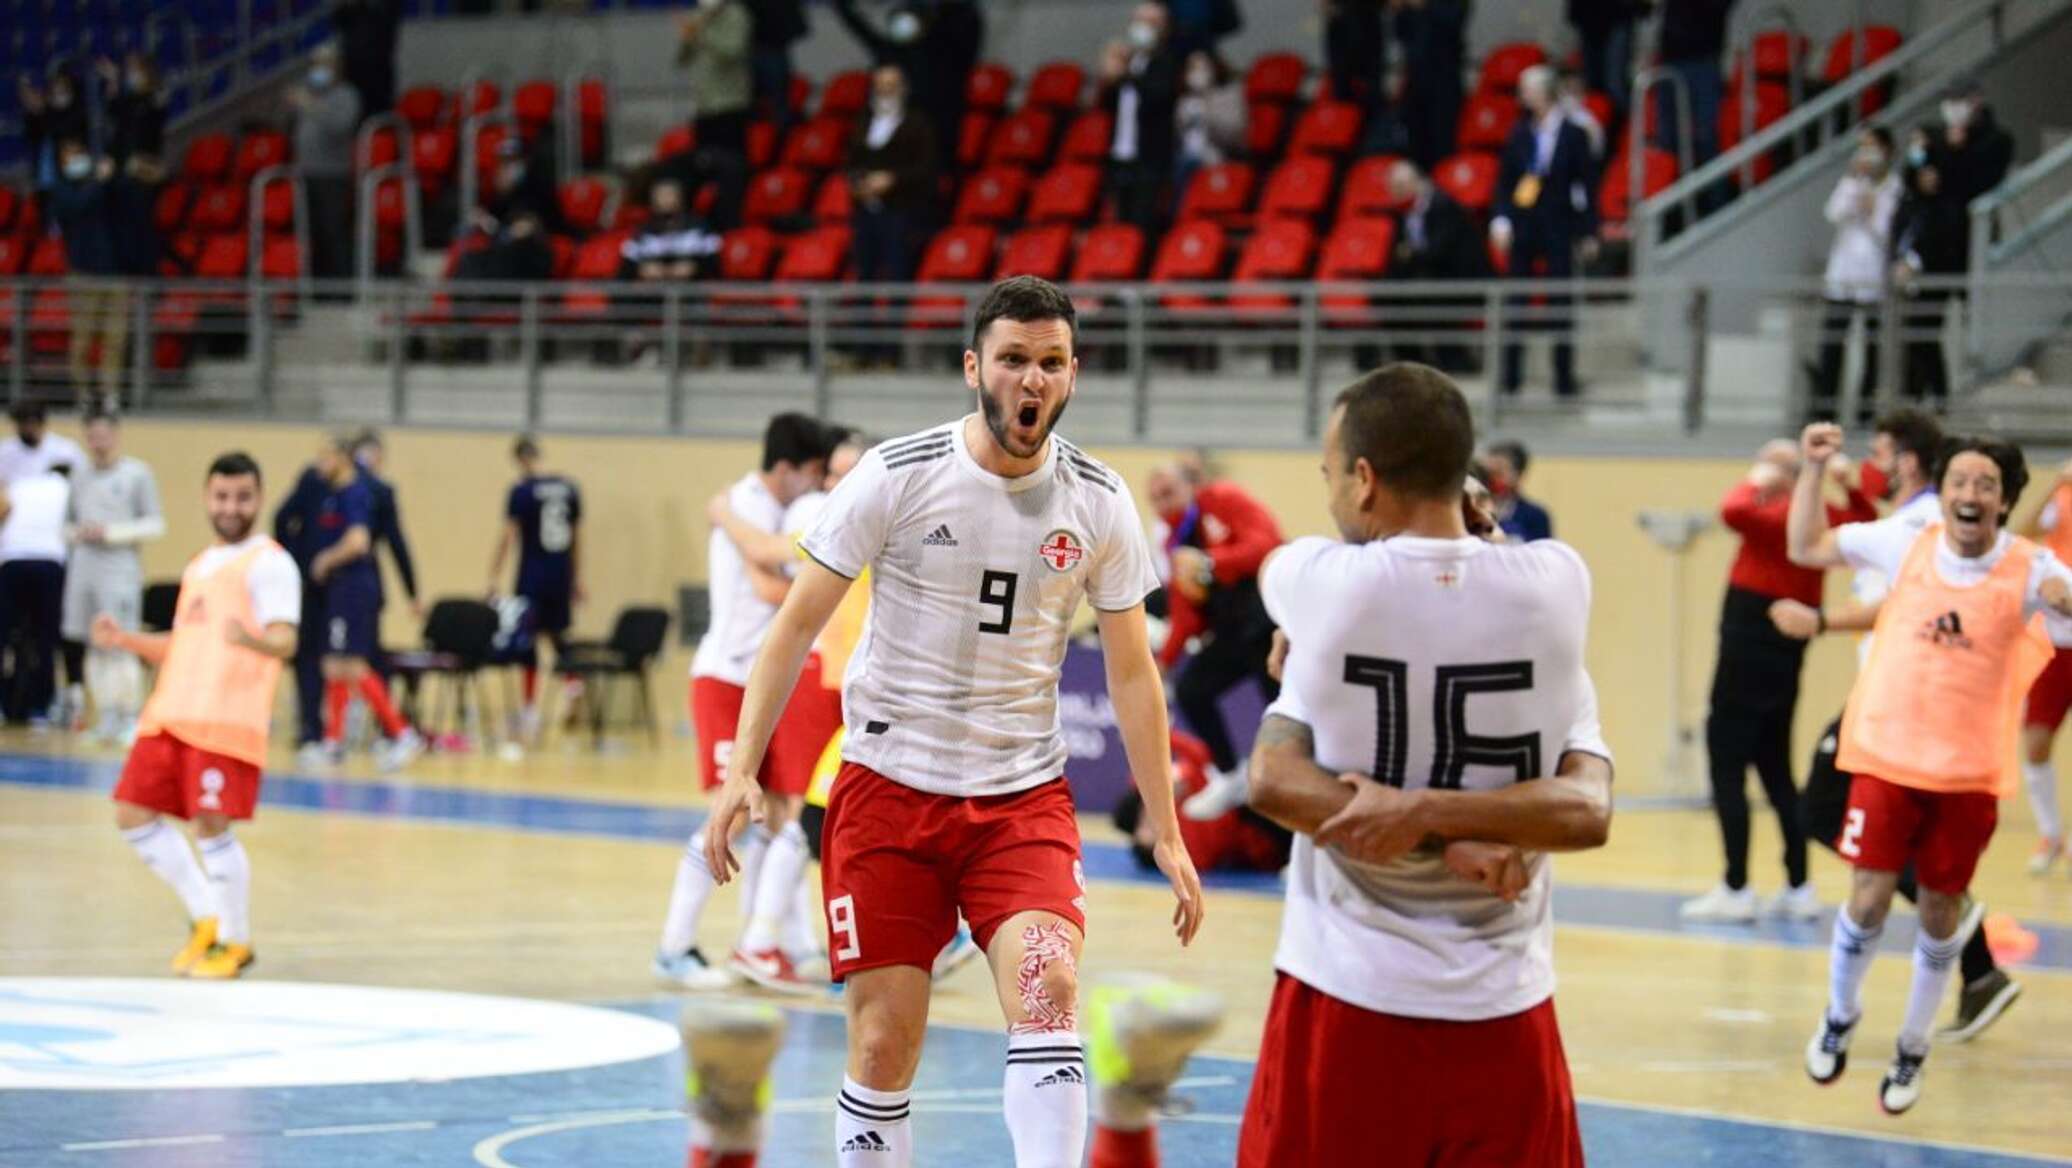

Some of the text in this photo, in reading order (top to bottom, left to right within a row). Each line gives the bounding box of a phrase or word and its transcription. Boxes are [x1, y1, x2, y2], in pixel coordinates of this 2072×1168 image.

[922, 537, 959, 546] adidas
[978, 570, 1018, 635] 9
[1343, 653, 1542, 791] 16
[1840, 807, 1866, 858] 2
[829, 894, 861, 961] 9
